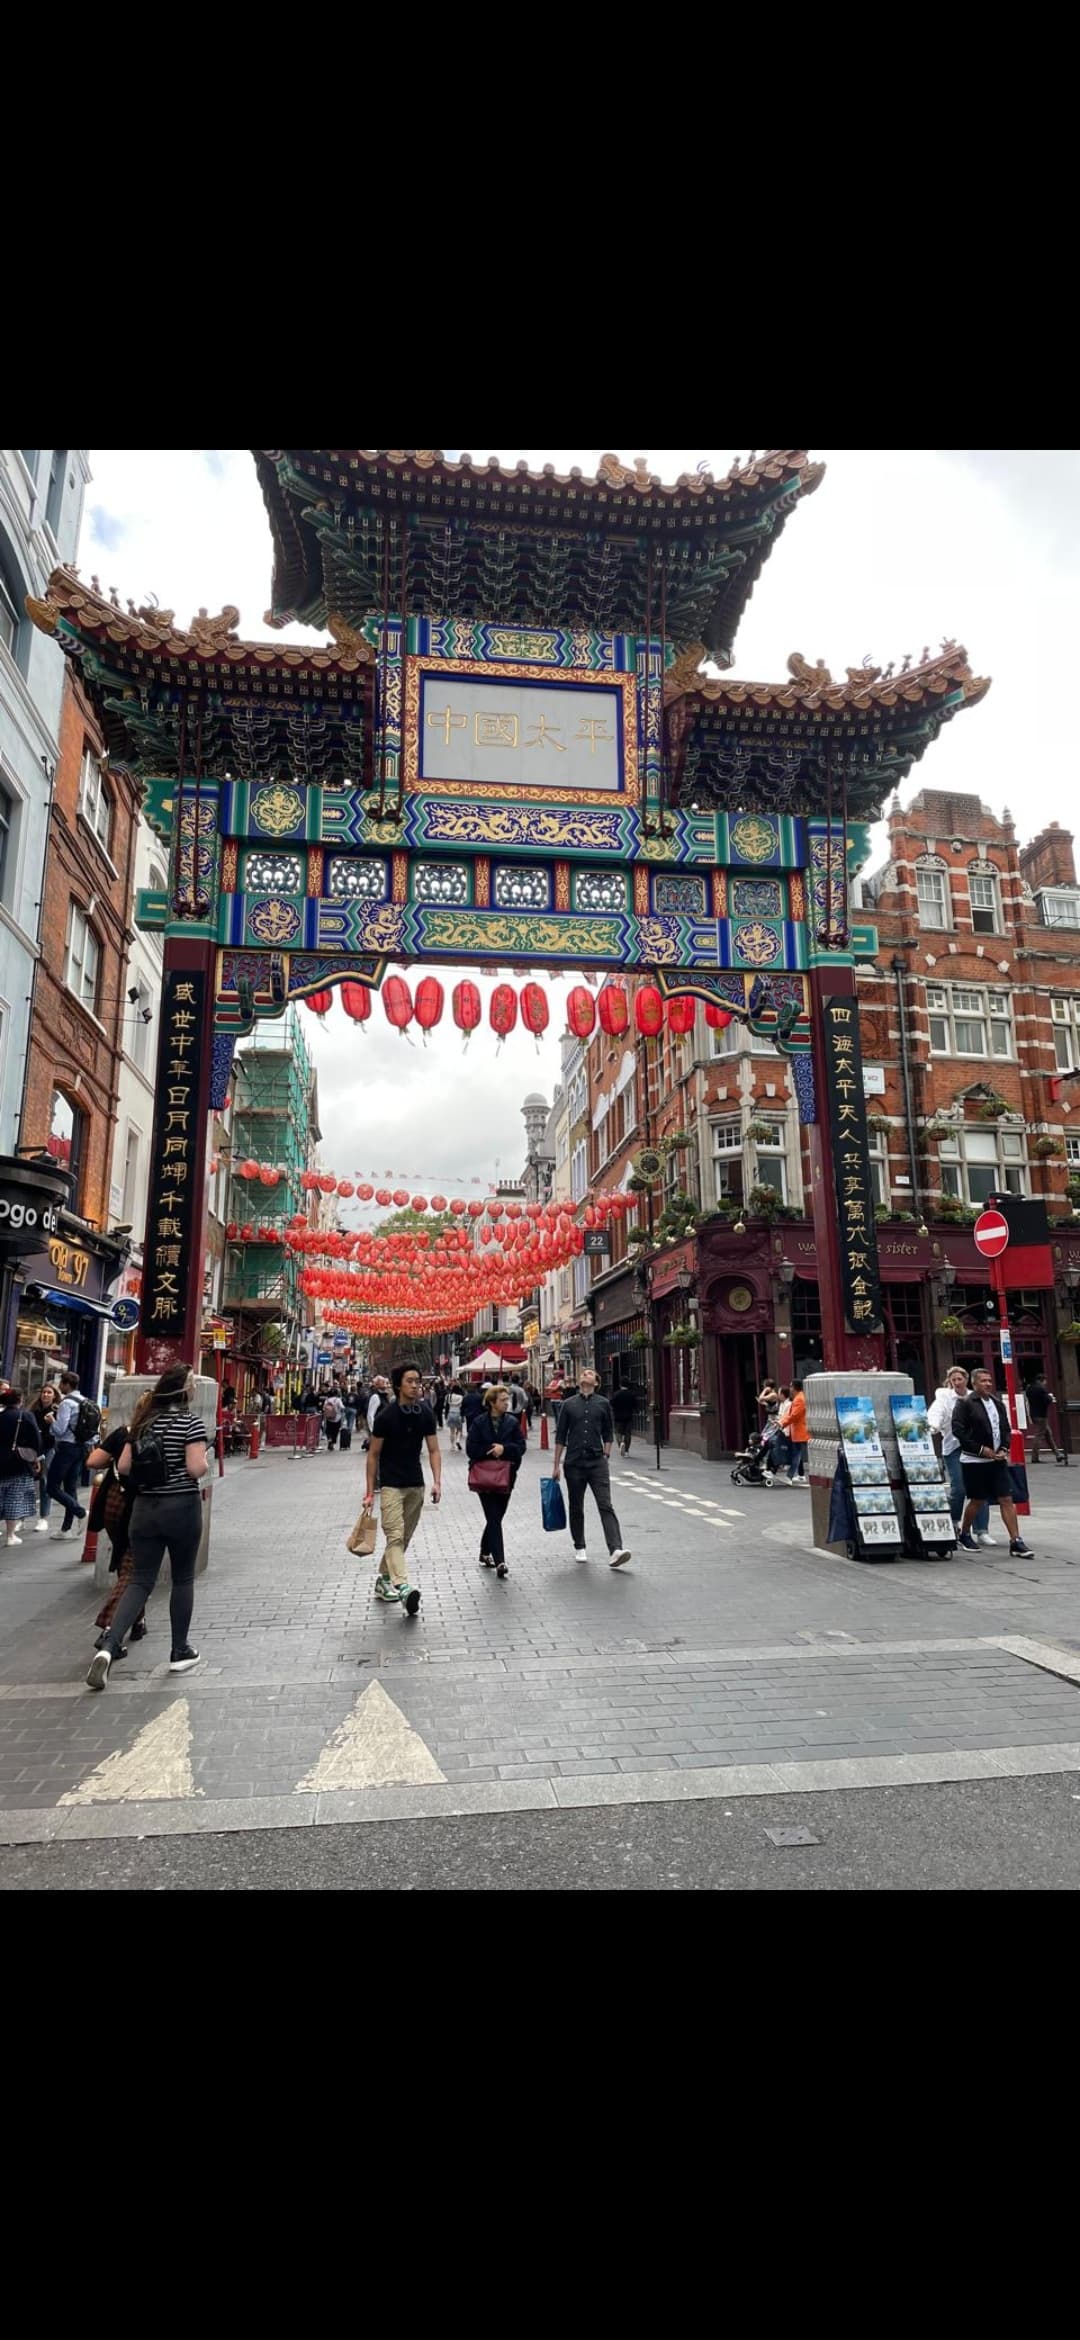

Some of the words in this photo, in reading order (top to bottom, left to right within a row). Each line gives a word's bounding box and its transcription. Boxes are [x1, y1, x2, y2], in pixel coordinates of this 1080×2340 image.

[426, 705, 615, 754] 中國太平
[43, 1202, 57, 1232] de
[590, 1236, 604, 1246] 22
[886, 1241, 919, 1255] sister
[51, 1246, 69, 1268] Old
